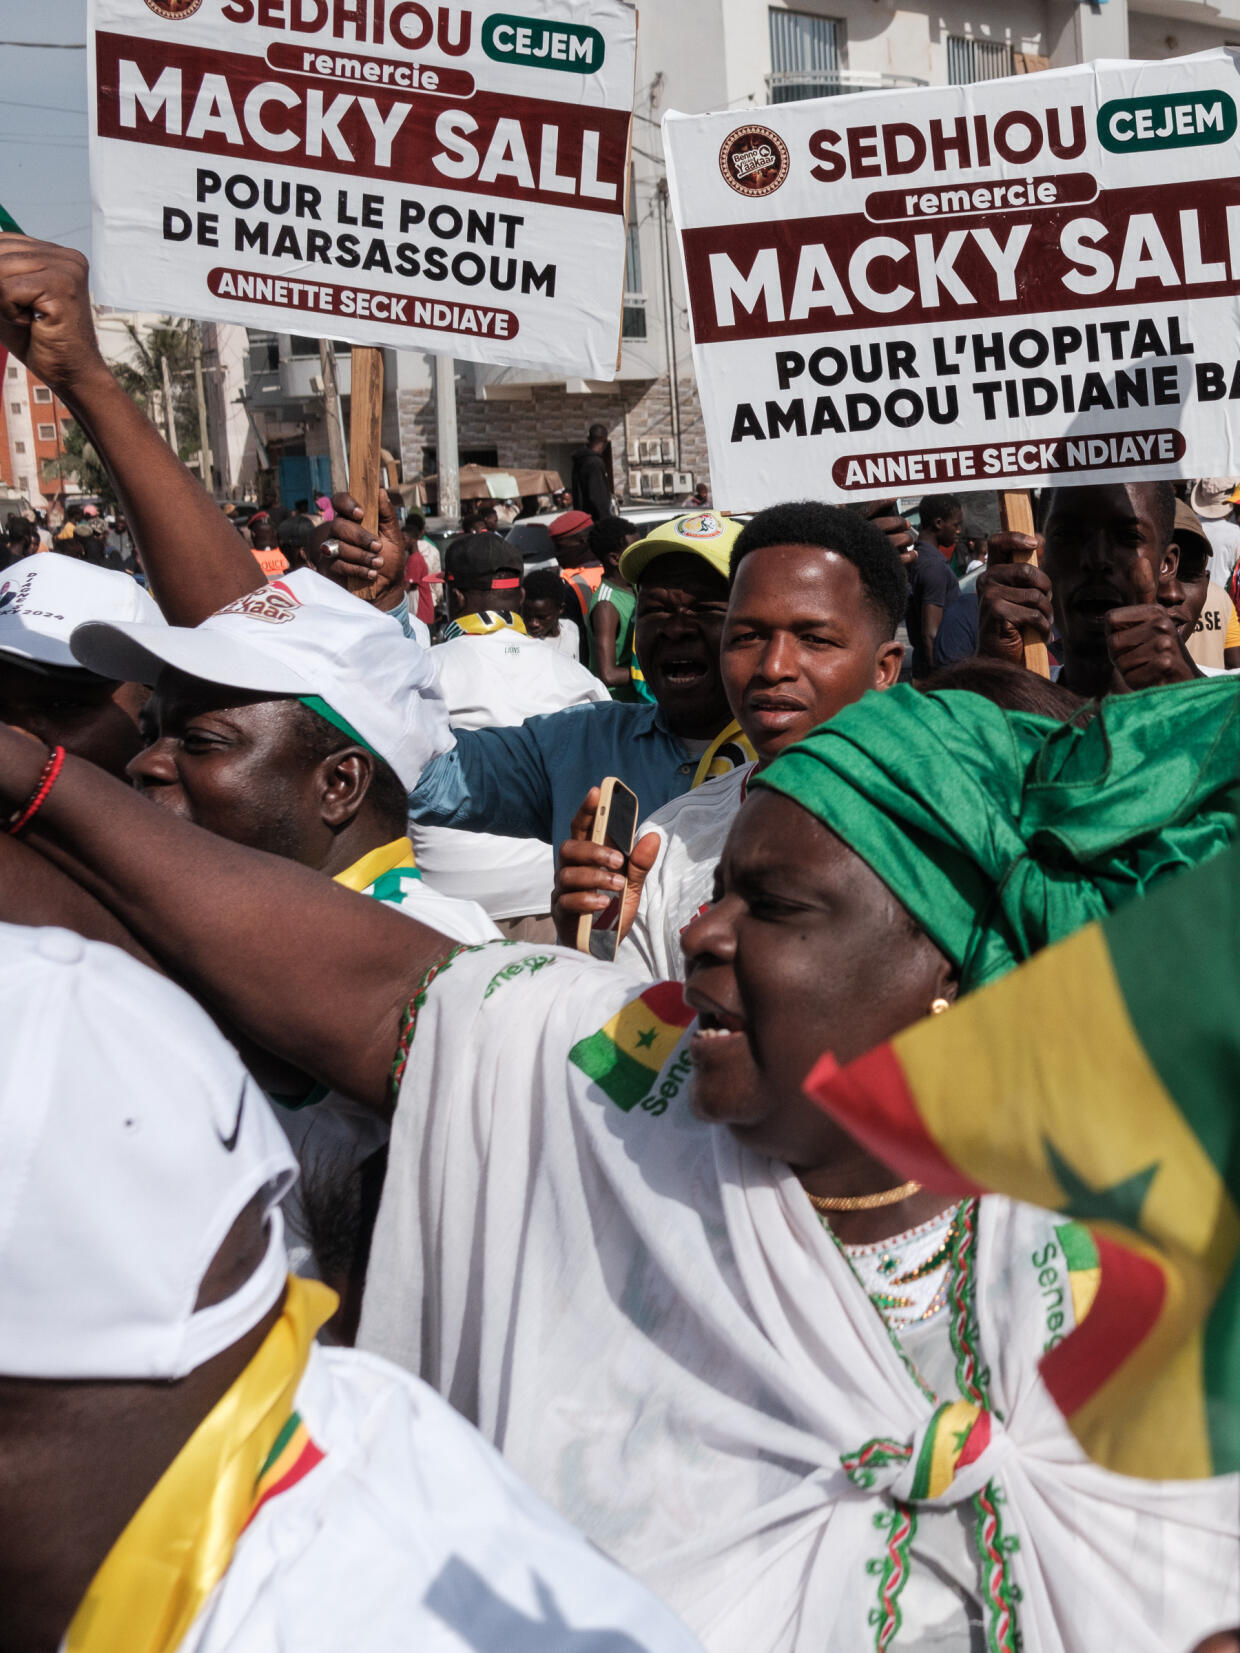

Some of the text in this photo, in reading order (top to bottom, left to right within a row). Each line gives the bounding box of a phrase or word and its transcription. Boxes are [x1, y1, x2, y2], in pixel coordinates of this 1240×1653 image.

[303, 49, 439, 90] remercie
[493, 25, 593, 63] CEJEM
[119, 59, 616, 200] MACKY SALL
[810, 102, 1223, 182] SEDHIOU CEJEM
[197, 169, 524, 248] POUR LE PONT
[905, 176, 1058, 216] remercie
[163, 207, 556, 297] DE MARSASSOUM
[708, 224, 1032, 326] MACKY
[218, 273, 509, 337] ANNETTE SECK NDIAYE
[776, 341, 919, 389] POUR
[731, 385, 958, 442] AMADOU
[973, 365, 1180, 420] TIDIANE
[846, 433, 1175, 485] ANNETTE SECK NDIAYE
